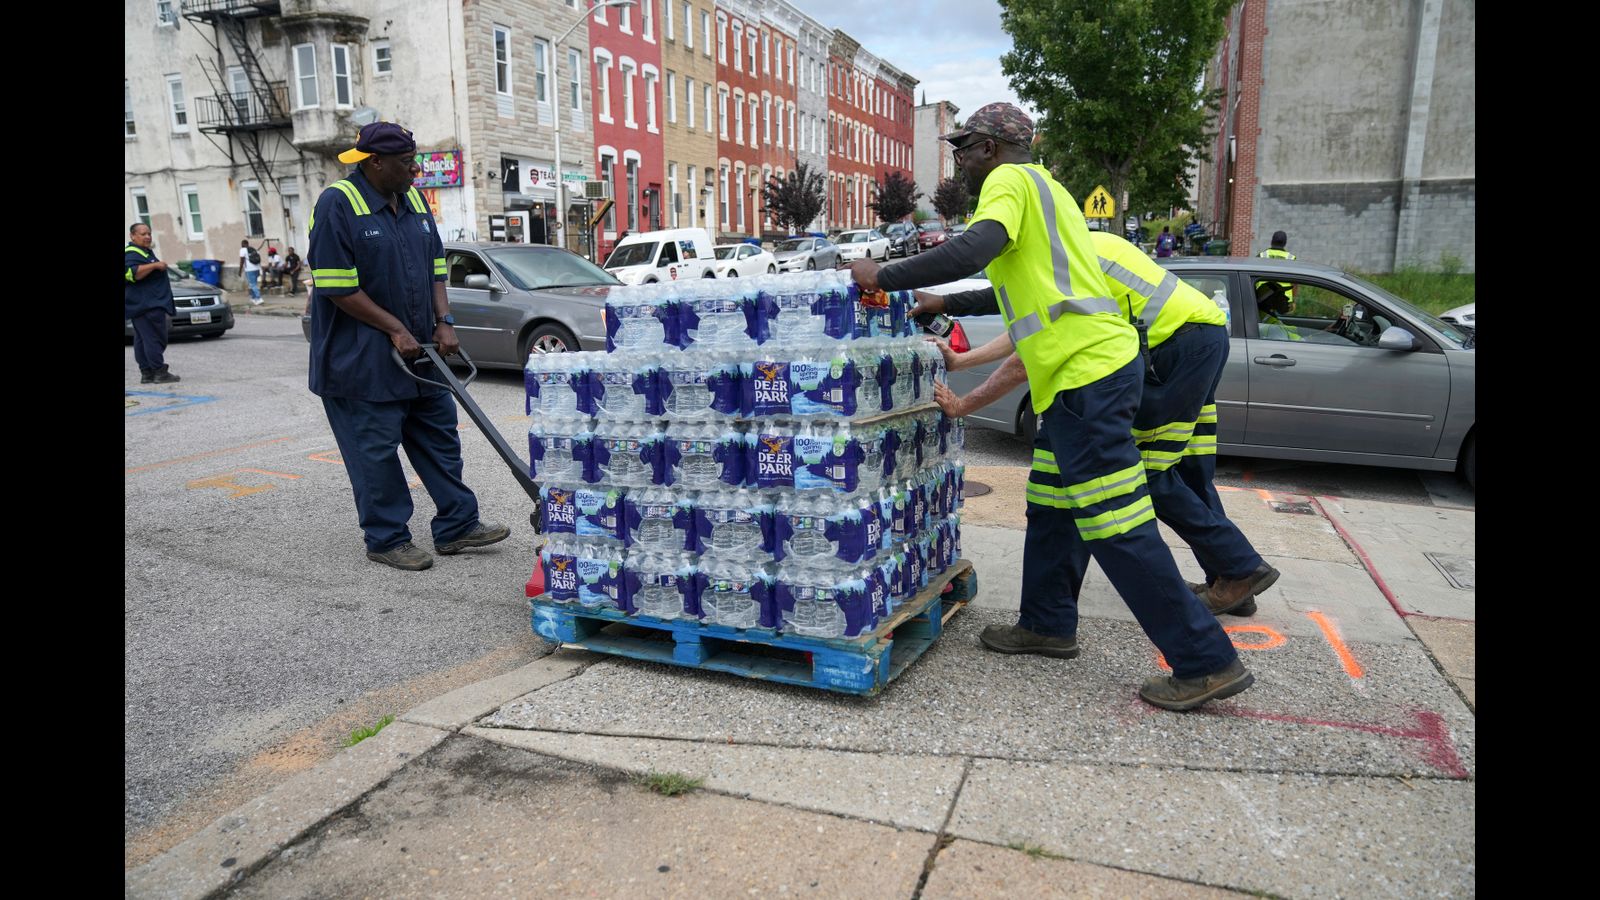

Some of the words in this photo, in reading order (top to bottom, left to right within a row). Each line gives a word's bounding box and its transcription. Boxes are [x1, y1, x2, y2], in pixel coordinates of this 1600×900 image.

[423, 157, 456, 172] Snacks
[754, 379, 788, 392] DEER
[755, 390, 789, 403] PARK
[758, 452, 792, 464] DEER
[759, 462, 793, 476] PARK
[547, 502, 575, 514] DEER
[548, 511, 575, 524] PARK
[550, 568, 576, 582] DEER
[551, 579, 577, 591] PARK
